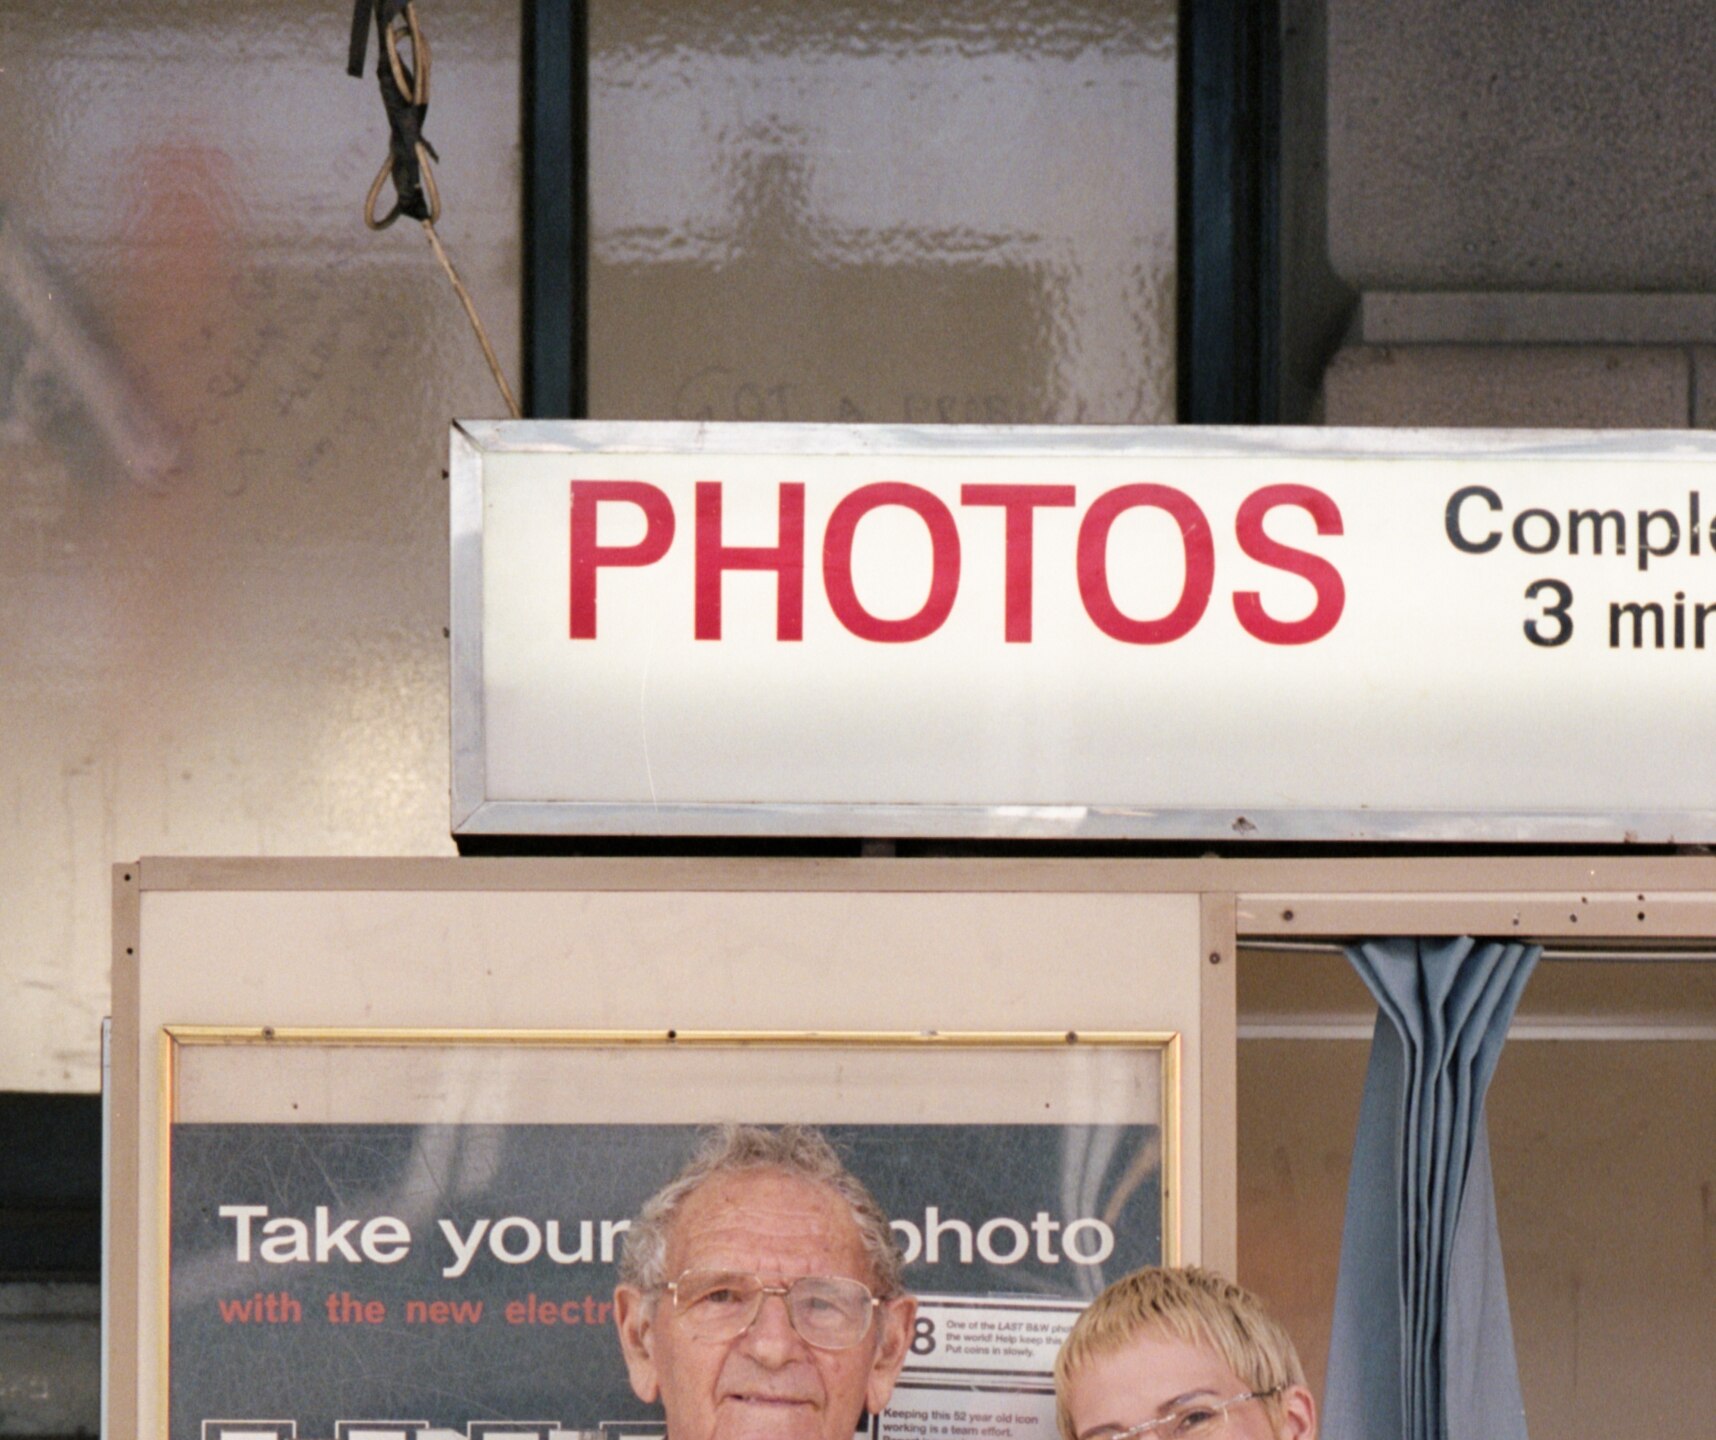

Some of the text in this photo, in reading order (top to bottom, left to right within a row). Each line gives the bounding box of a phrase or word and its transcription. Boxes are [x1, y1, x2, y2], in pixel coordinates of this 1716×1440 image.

[1444, 485, 1716, 571] Compl
[569, 480, 1346, 645] PHOTOS
[1523, 578, 1574, 647] 3
[219, 1205, 411, 1264] Take
[438, 1216, 632, 1278] your
[219, 1292, 613, 1326] with the new electr
[910, 1317, 936, 1356] 8
[946, 1320, 966, 1330] One
[968, 1321, 979, 1331] of
[981, 1322, 996, 1331] the
[998, 1322, 1024, 1332] LAST
[1026, 1323, 1050, 1333] B&W
[946, 1333, 961, 1342] the
[996, 1335, 1018, 1346] Help
[946, 1345, 1034, 1359] Put coins in slowly.
[883, 1423, 1014, 1438] working is a team effort.
[884, 1408, 1039, 1425] Keeping this 52 year old icon
